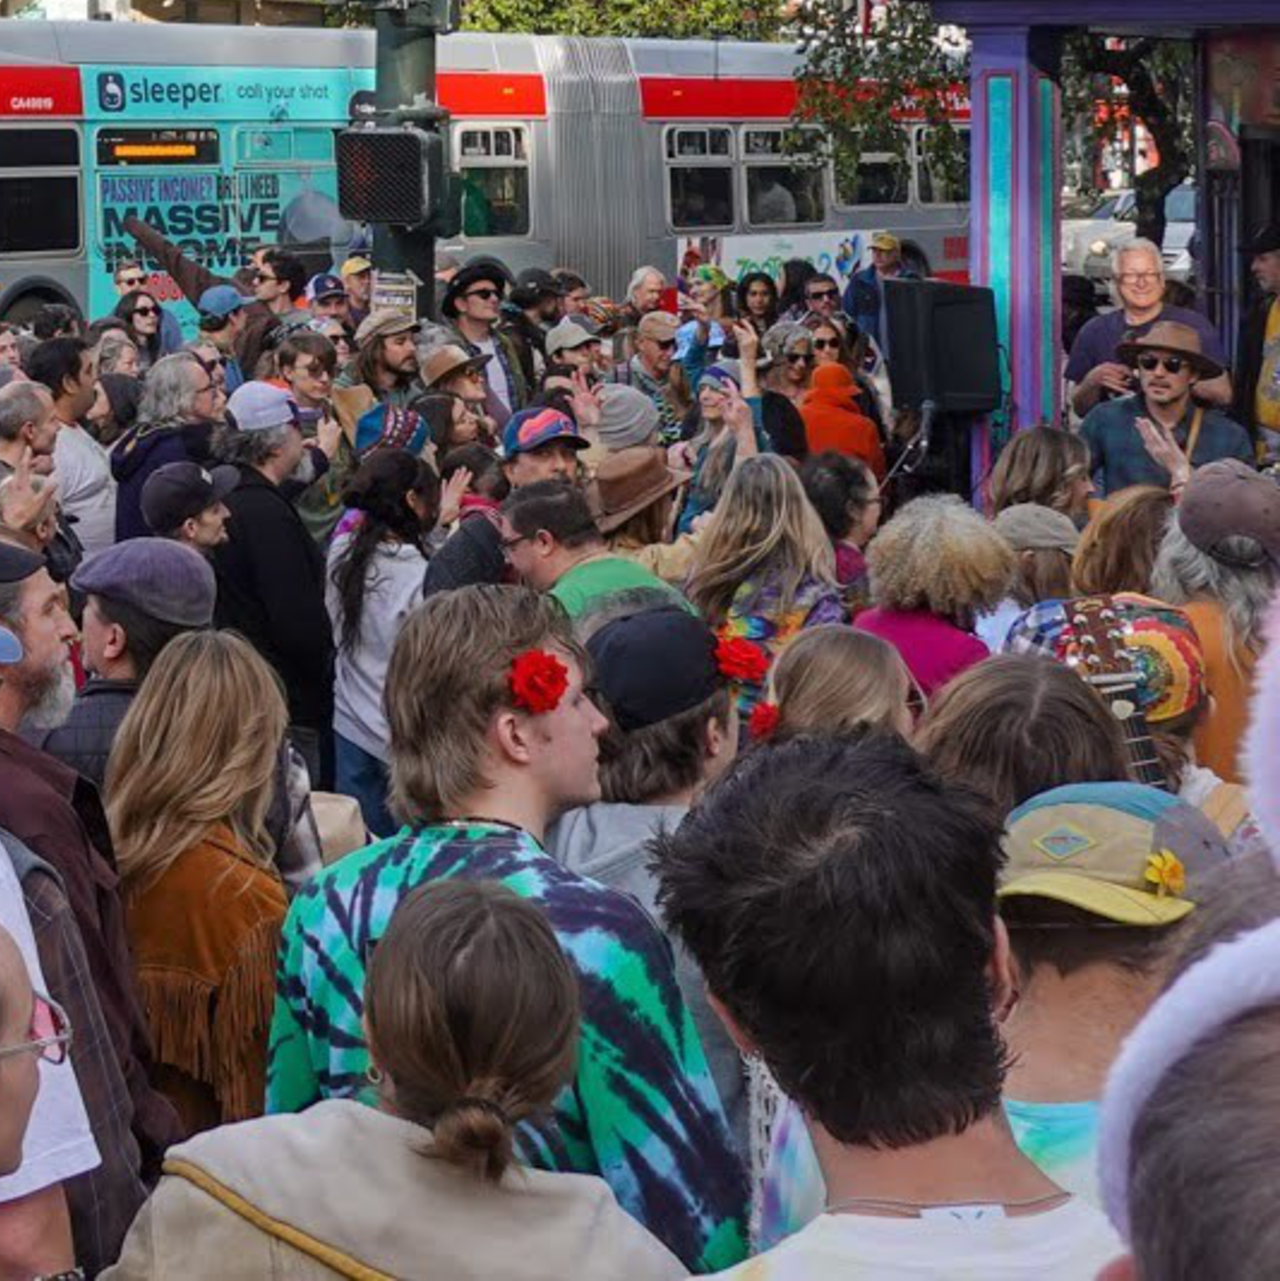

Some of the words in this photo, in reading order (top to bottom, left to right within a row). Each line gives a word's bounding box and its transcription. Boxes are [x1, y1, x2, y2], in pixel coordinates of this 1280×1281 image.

[130, 77, 222, 110] sleeper
[264, 86, 296, 103] your
[299, 84, 329, 99] shot
[101, 177, 156, 203] PASSIVE
[158, 176, 214, 202] INCOME?
[103, 203, 281, 238] MASSIVE
